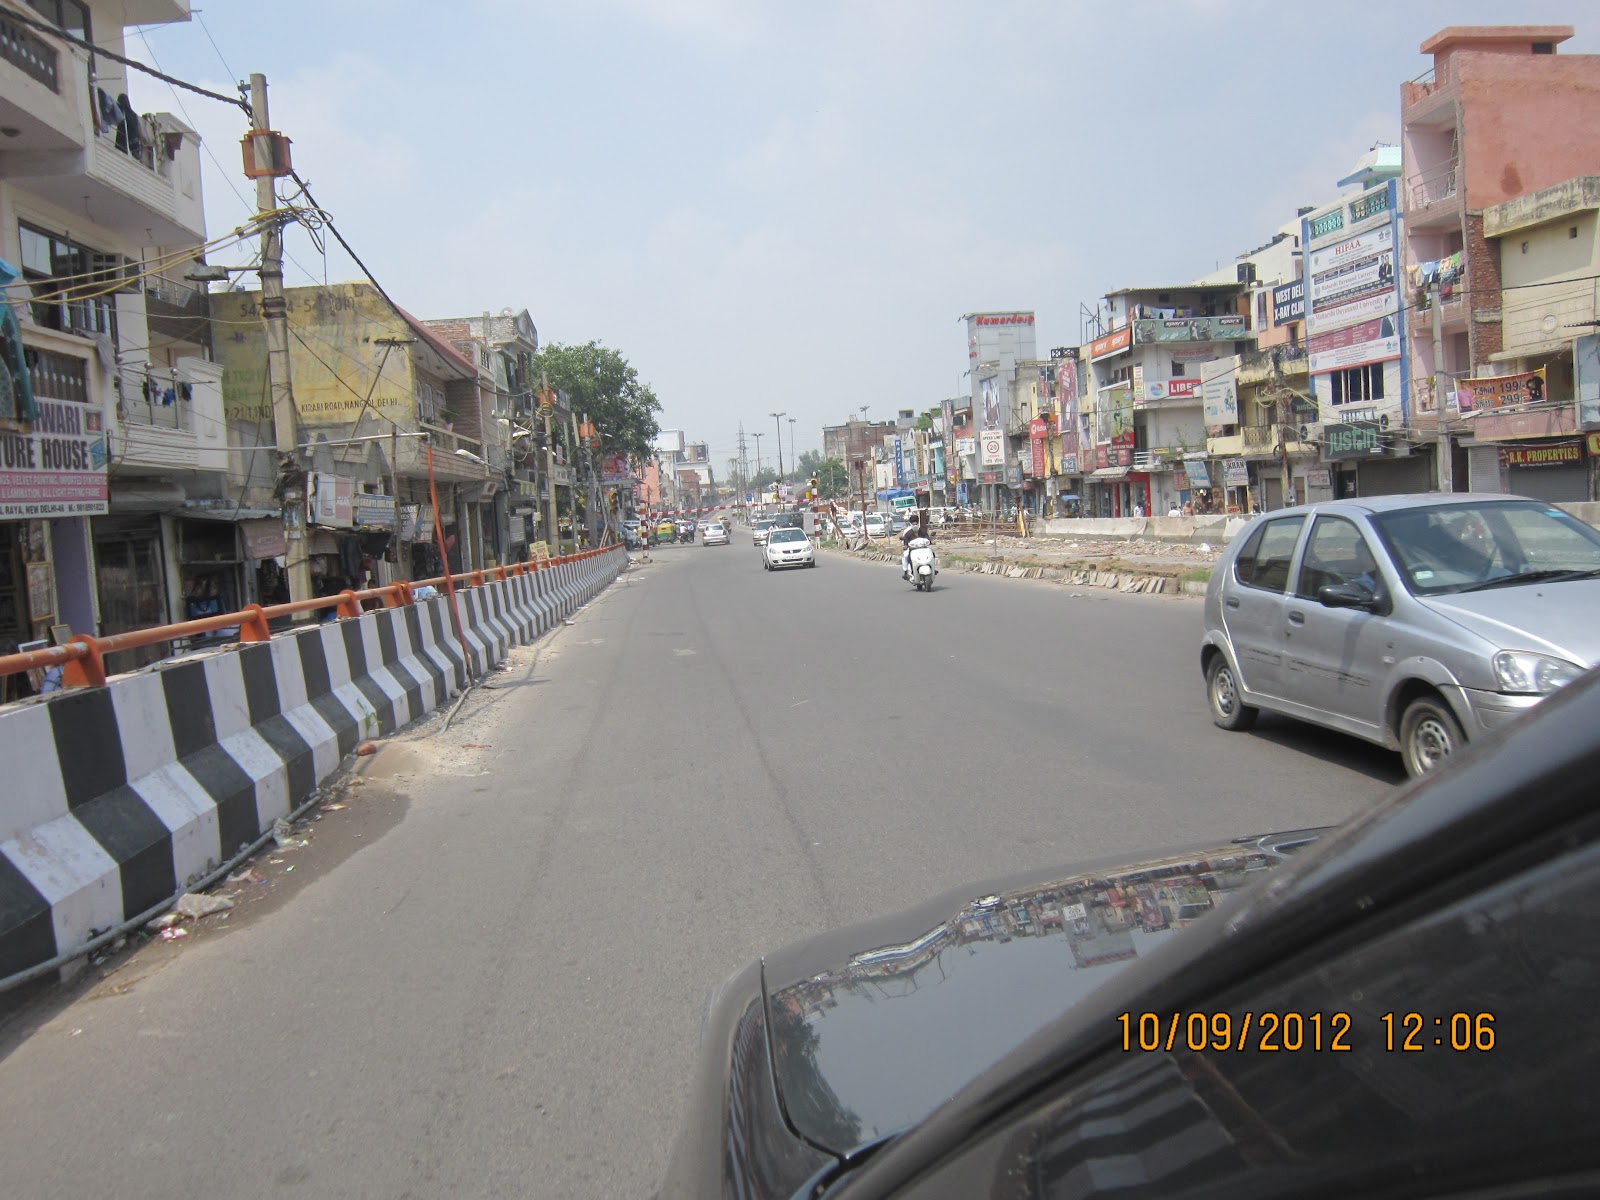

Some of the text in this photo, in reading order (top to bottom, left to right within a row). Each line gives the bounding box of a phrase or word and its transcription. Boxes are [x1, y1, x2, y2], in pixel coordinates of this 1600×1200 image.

[1335, 240, 1361, 255] HIFAA
[1275, 288, 1291, 304] WEST
[1291, 284, 1304, 298] DEL
[1275, 304, 1290, 321] X-RAY
[41, 439, 89, 470] HOUSE
[1527, 447, 1579, 462] PROPERTIES
[25, 505, 39, 514] NEW
